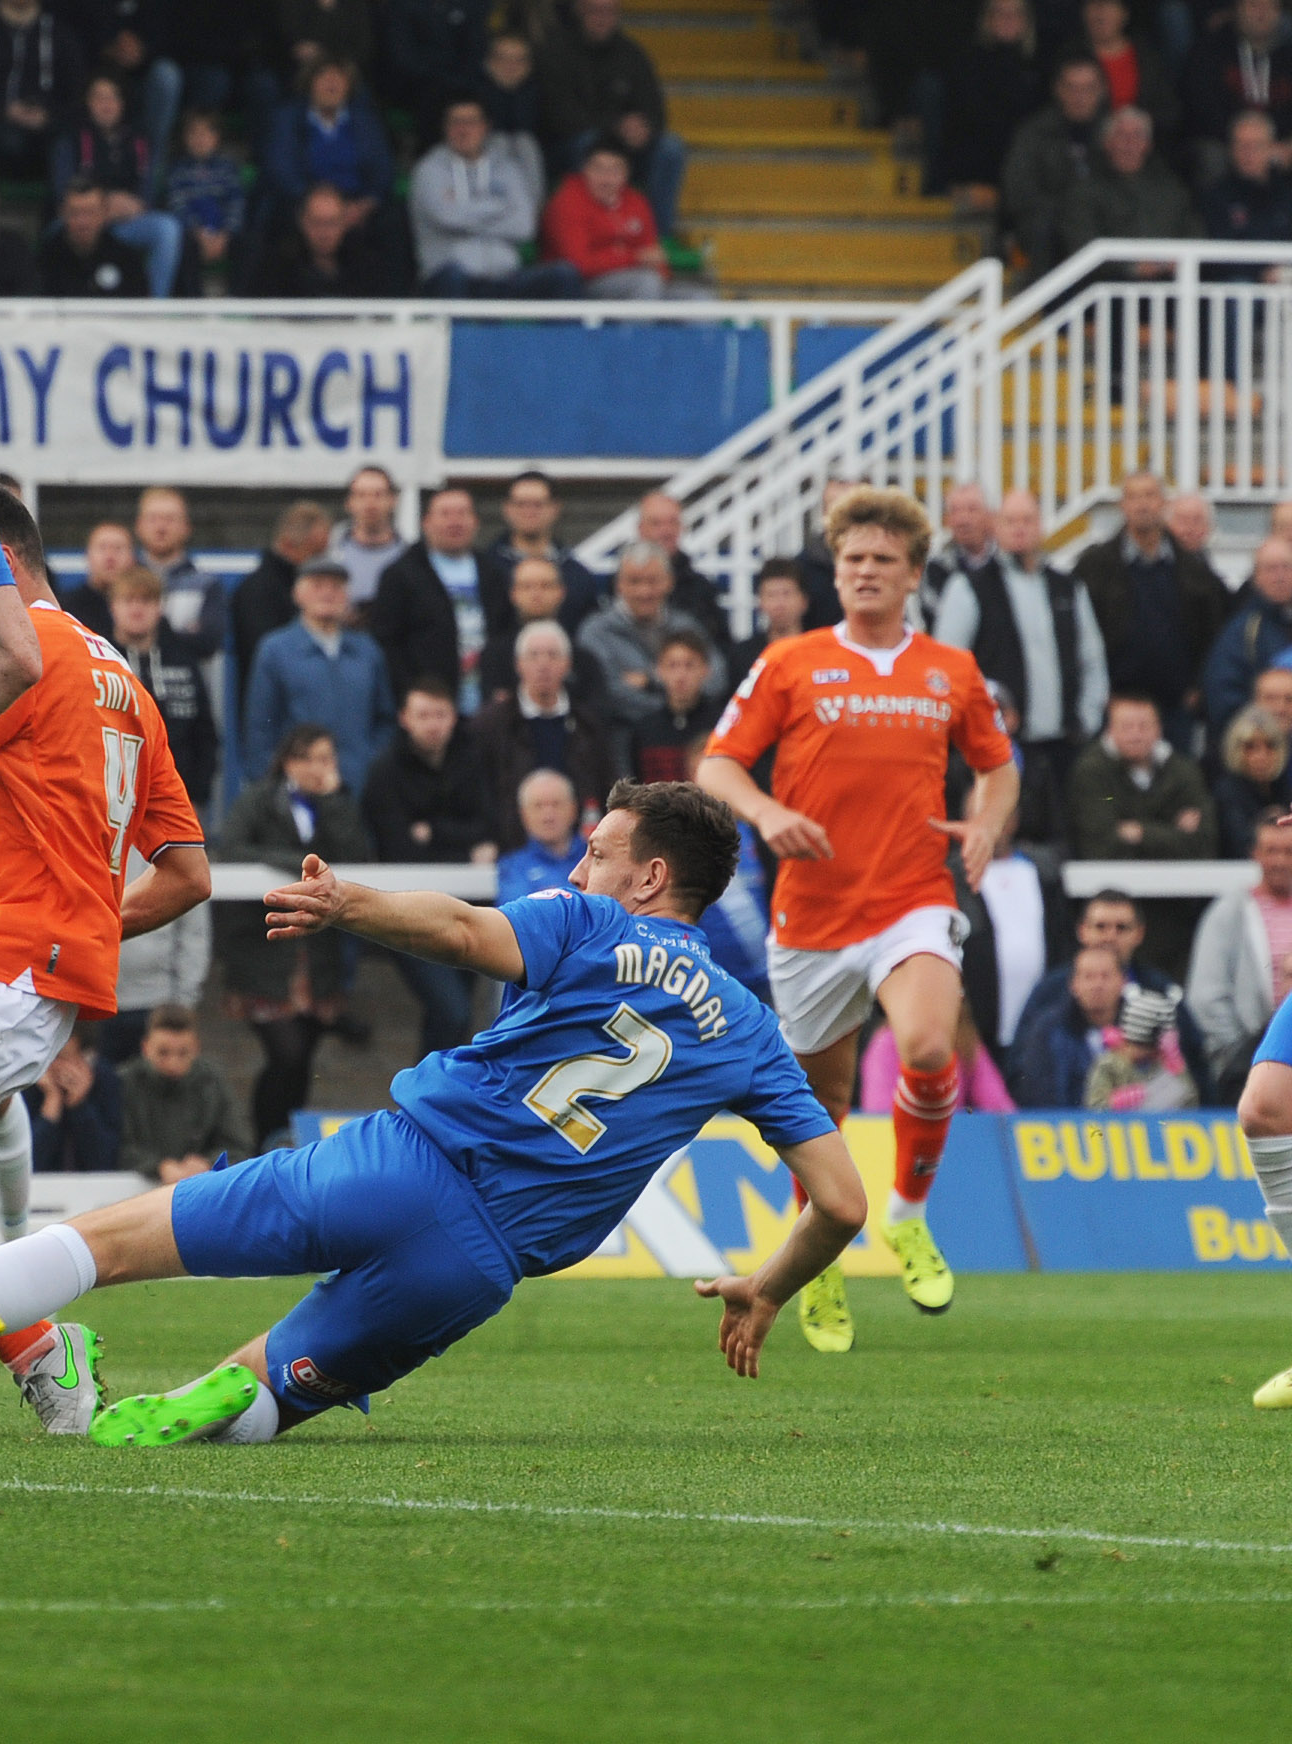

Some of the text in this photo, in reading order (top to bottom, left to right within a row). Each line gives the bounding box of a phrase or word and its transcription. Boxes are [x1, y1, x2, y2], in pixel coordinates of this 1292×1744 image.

[95, 341, 411, 450] CHURCH
[847, 693, 952, 722] BARNFIELD
[101, 726, 145, 875] 4
[613, 942, 729, 1042] MAGNAY
[521, 1001, 673, 1156] 2
[1014, 1119, 1258, 1182] BUILDI
